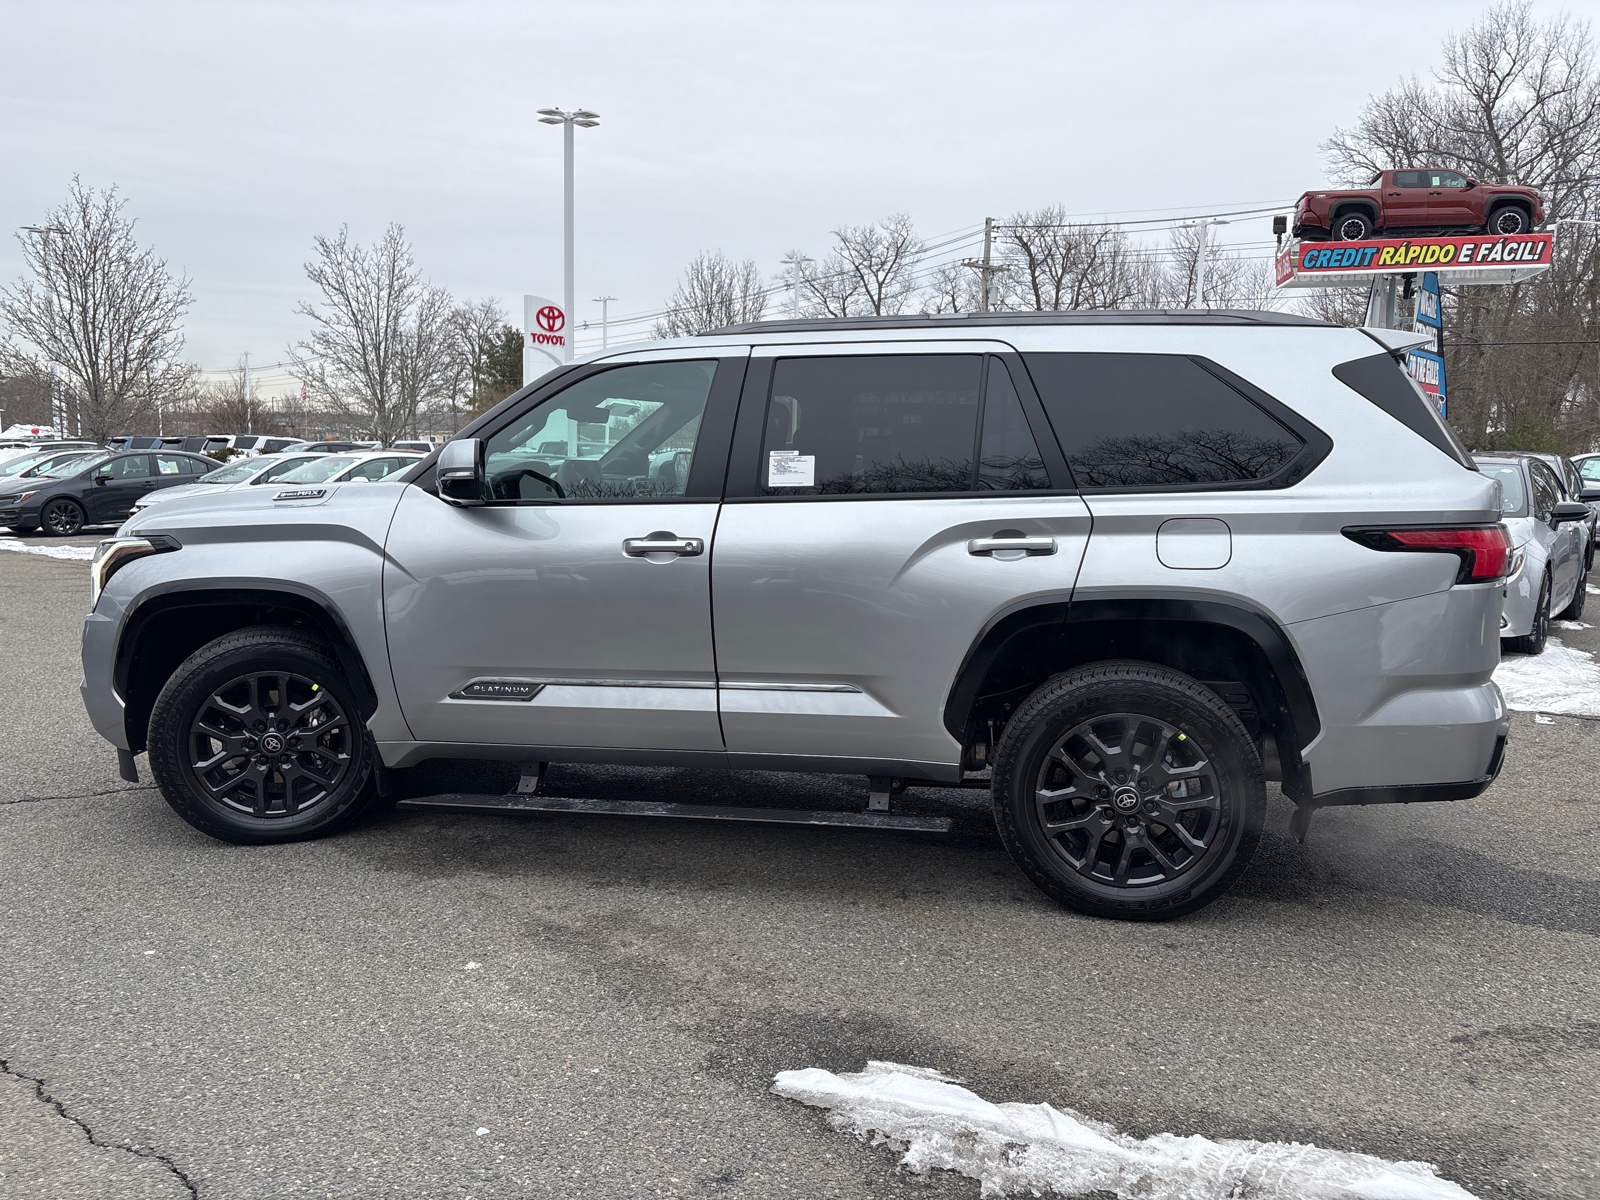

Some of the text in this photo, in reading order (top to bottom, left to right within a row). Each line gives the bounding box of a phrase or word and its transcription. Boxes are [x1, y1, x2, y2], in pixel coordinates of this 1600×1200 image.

[1303, 238, 1544, 268] CREDIT RÁPIDO E FÁCIL!
[473, 685, 529, 693] PLATINUM
